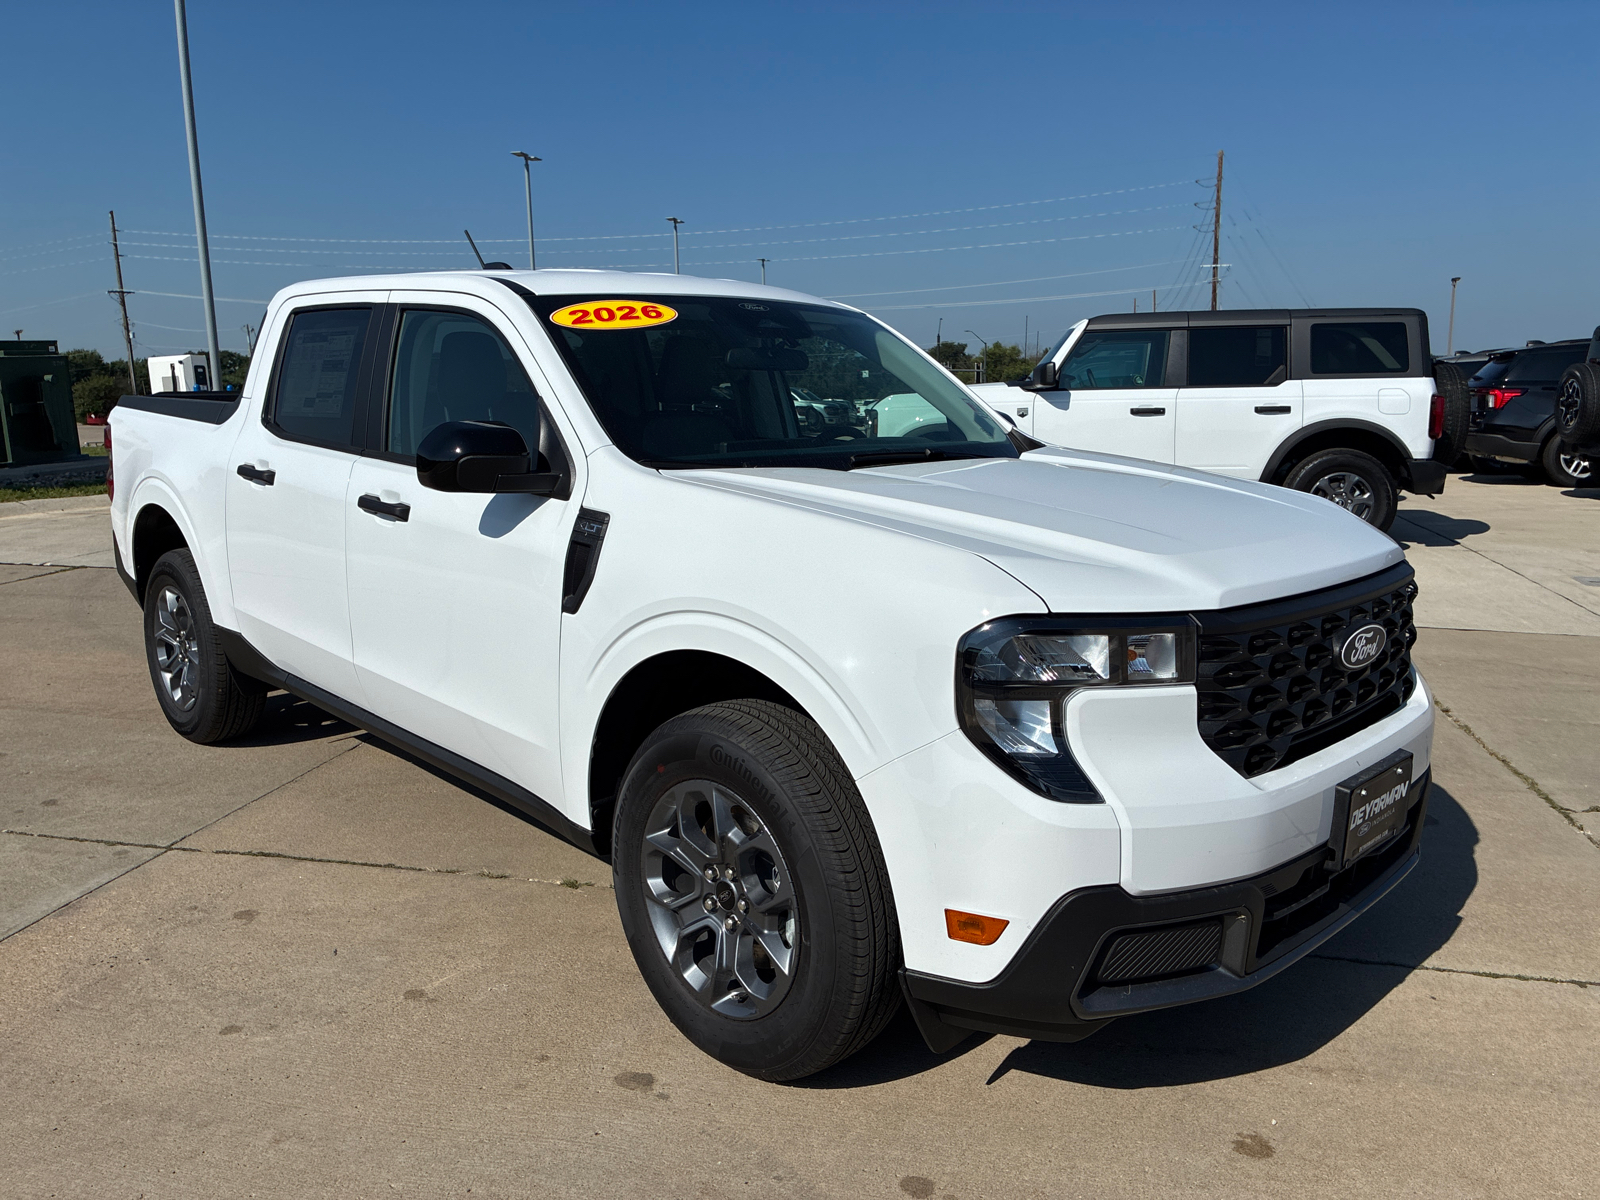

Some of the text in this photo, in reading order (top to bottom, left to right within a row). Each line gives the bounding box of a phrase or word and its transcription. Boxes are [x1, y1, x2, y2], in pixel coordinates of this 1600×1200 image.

[568, 305, 664, 325] 2026
[1351, 631, 1380, 663] Ford
[709, 743, 789, 820] Continental
[1350, 780, 1410, 831] DEYARMAN
